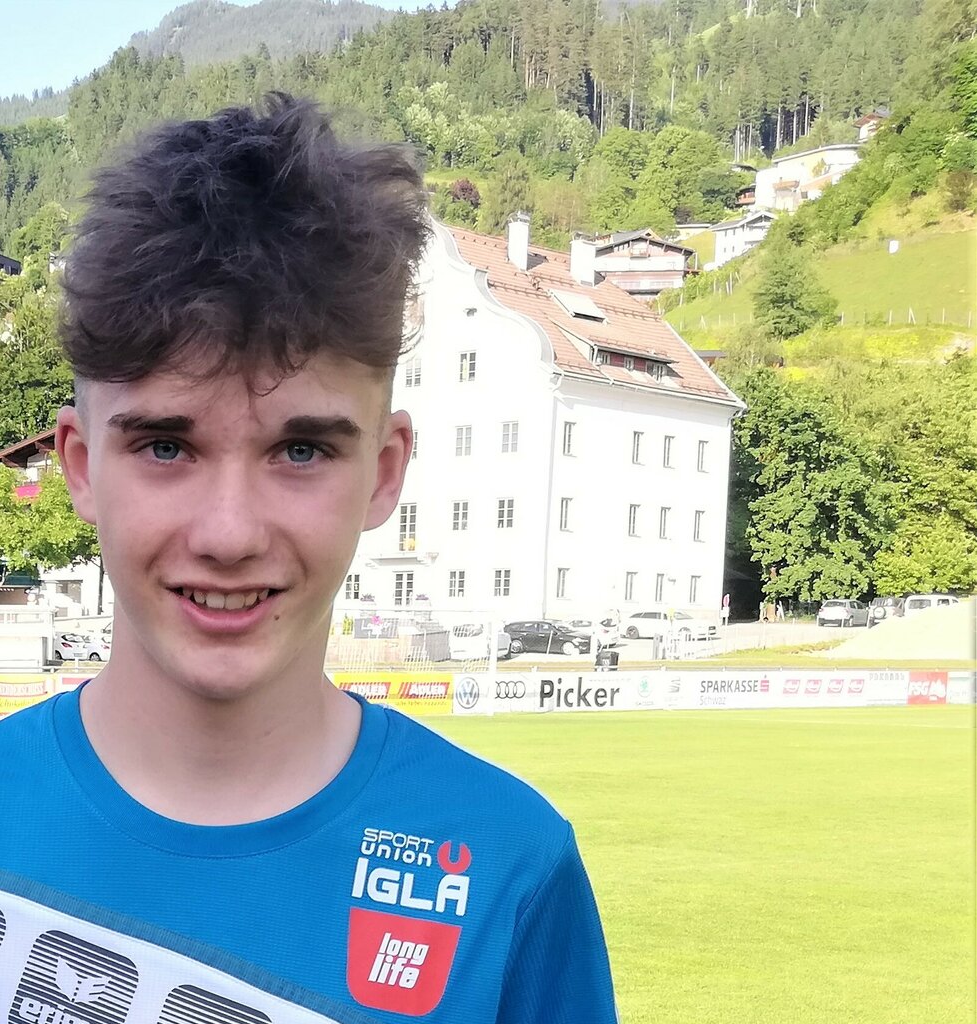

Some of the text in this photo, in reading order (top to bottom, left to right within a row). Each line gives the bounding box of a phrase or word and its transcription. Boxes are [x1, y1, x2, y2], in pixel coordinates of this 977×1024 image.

[540, 677, 620, 708] Picker
[699, 695, 726, 705] Schwaz
[700, 680, 759, 693] SPARKASSE
[361, 841, 432, 867] union
[364, 828, 434, 853] SPORT
[351, 857, 470, 916] IGLA
[379, 932, 429, 966] long
[368, 953, 420, 989] life
